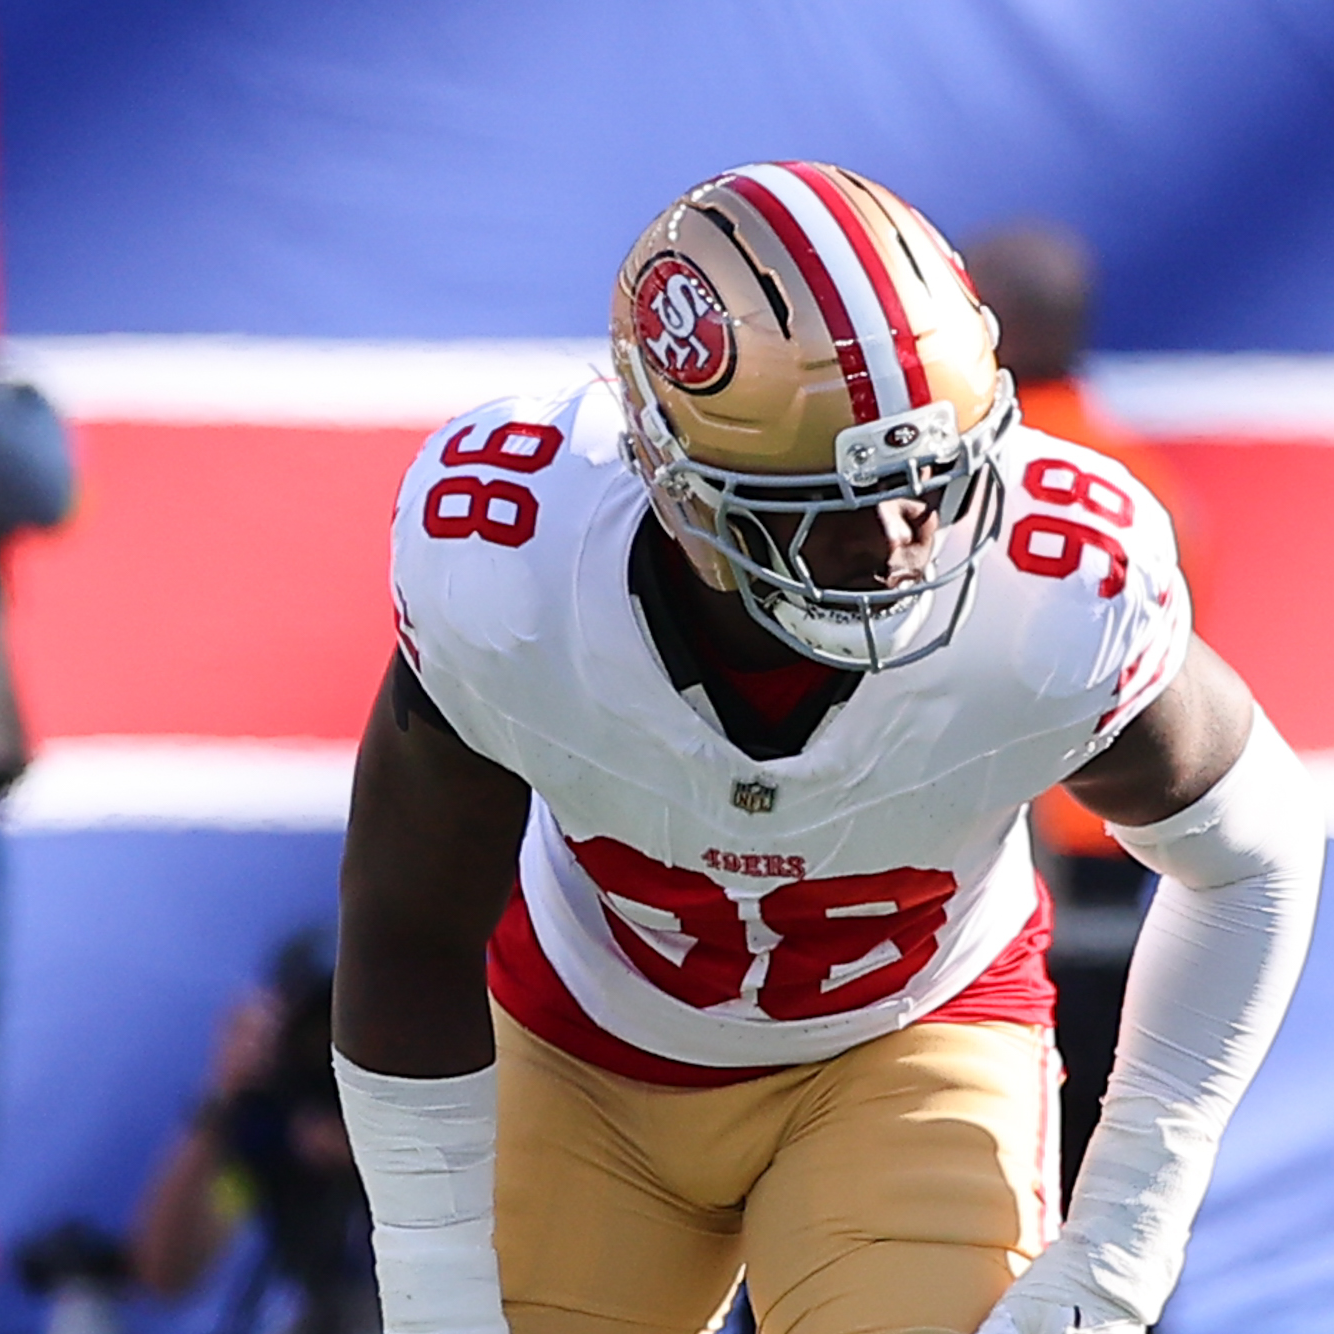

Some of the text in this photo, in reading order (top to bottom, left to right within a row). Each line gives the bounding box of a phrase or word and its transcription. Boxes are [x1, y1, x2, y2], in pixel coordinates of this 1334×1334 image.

[646, 273, 710, 370] SF
[422, 420, 565, 548] 98
[1007, 457, 1135, 599] 98
[564, 834, 958, 1021] 98
[701, 847, 806, 880] 49ERS
